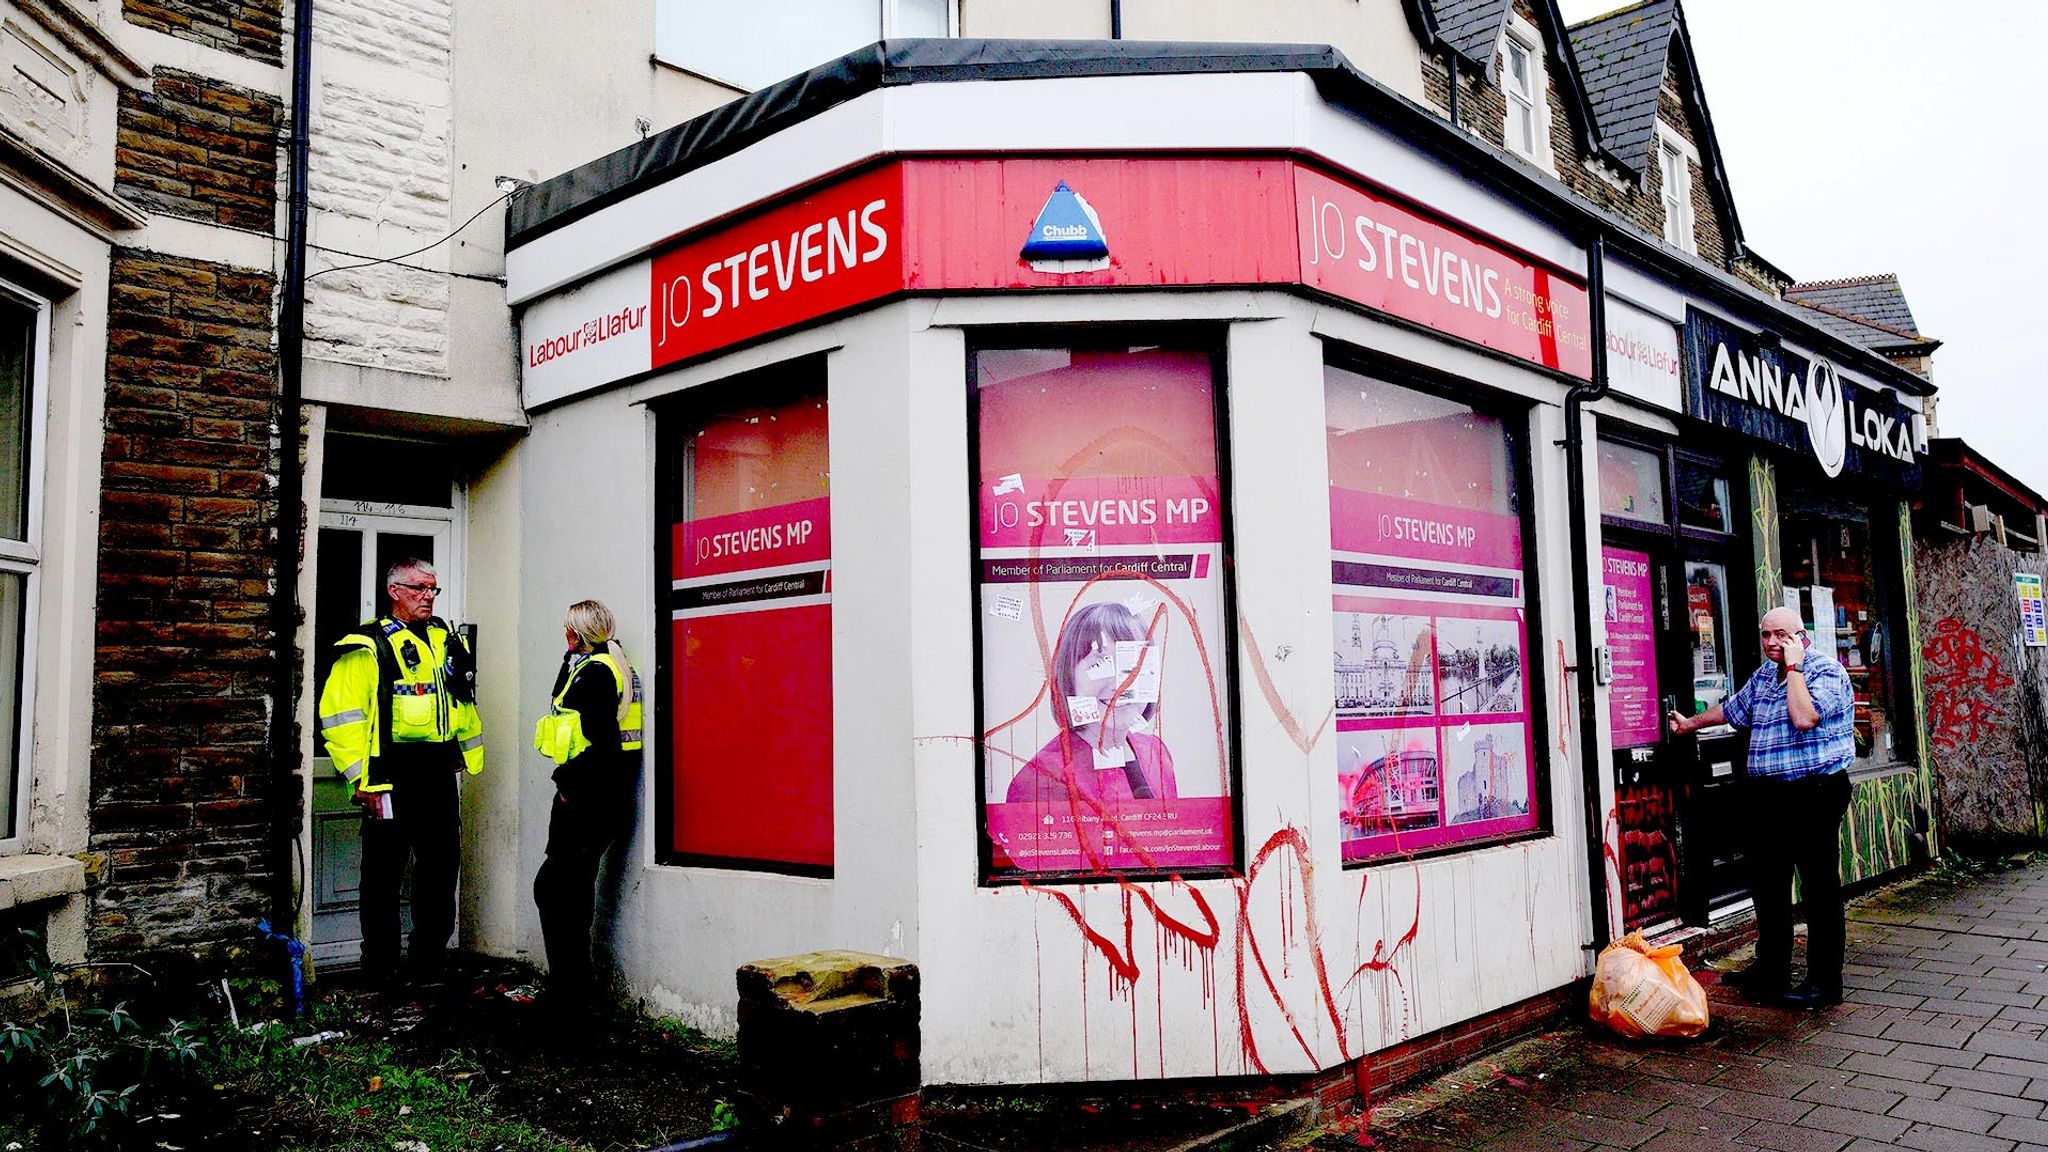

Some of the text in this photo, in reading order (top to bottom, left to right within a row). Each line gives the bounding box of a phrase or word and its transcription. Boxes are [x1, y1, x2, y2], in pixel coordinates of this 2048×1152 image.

[1043, 224, 1088, 236] Chubb
[658, 199, 888, 347] JO STEVENS
[1310, 195, 1502, 319] JO STEVENS
[1504, 278, 1569, 320] A strong voice
[530, 305, 647, 368] Labour Llafur
[1506, 304, 1587, 351] for Cardiff Central
[1606, 328, 1637, 360] abour
[1709, 341, 1915, 464] ANNA LOKA
[990, 497, 1209, 534] JO STEVENS MP
[1377, 514, 1476, 548] JO STEVENS MP
[695, 519, 813, 566] JO STEVENS MP
[764, 581, 783, 593] Cardiff
[783, 579, 805, 591] Central
[992, 561, 1187, 576] Member of Parliament for Cardiff Central
[1607, 557, 1637, 577] STEVENS
[1637, 562, 1648, 577] MP
